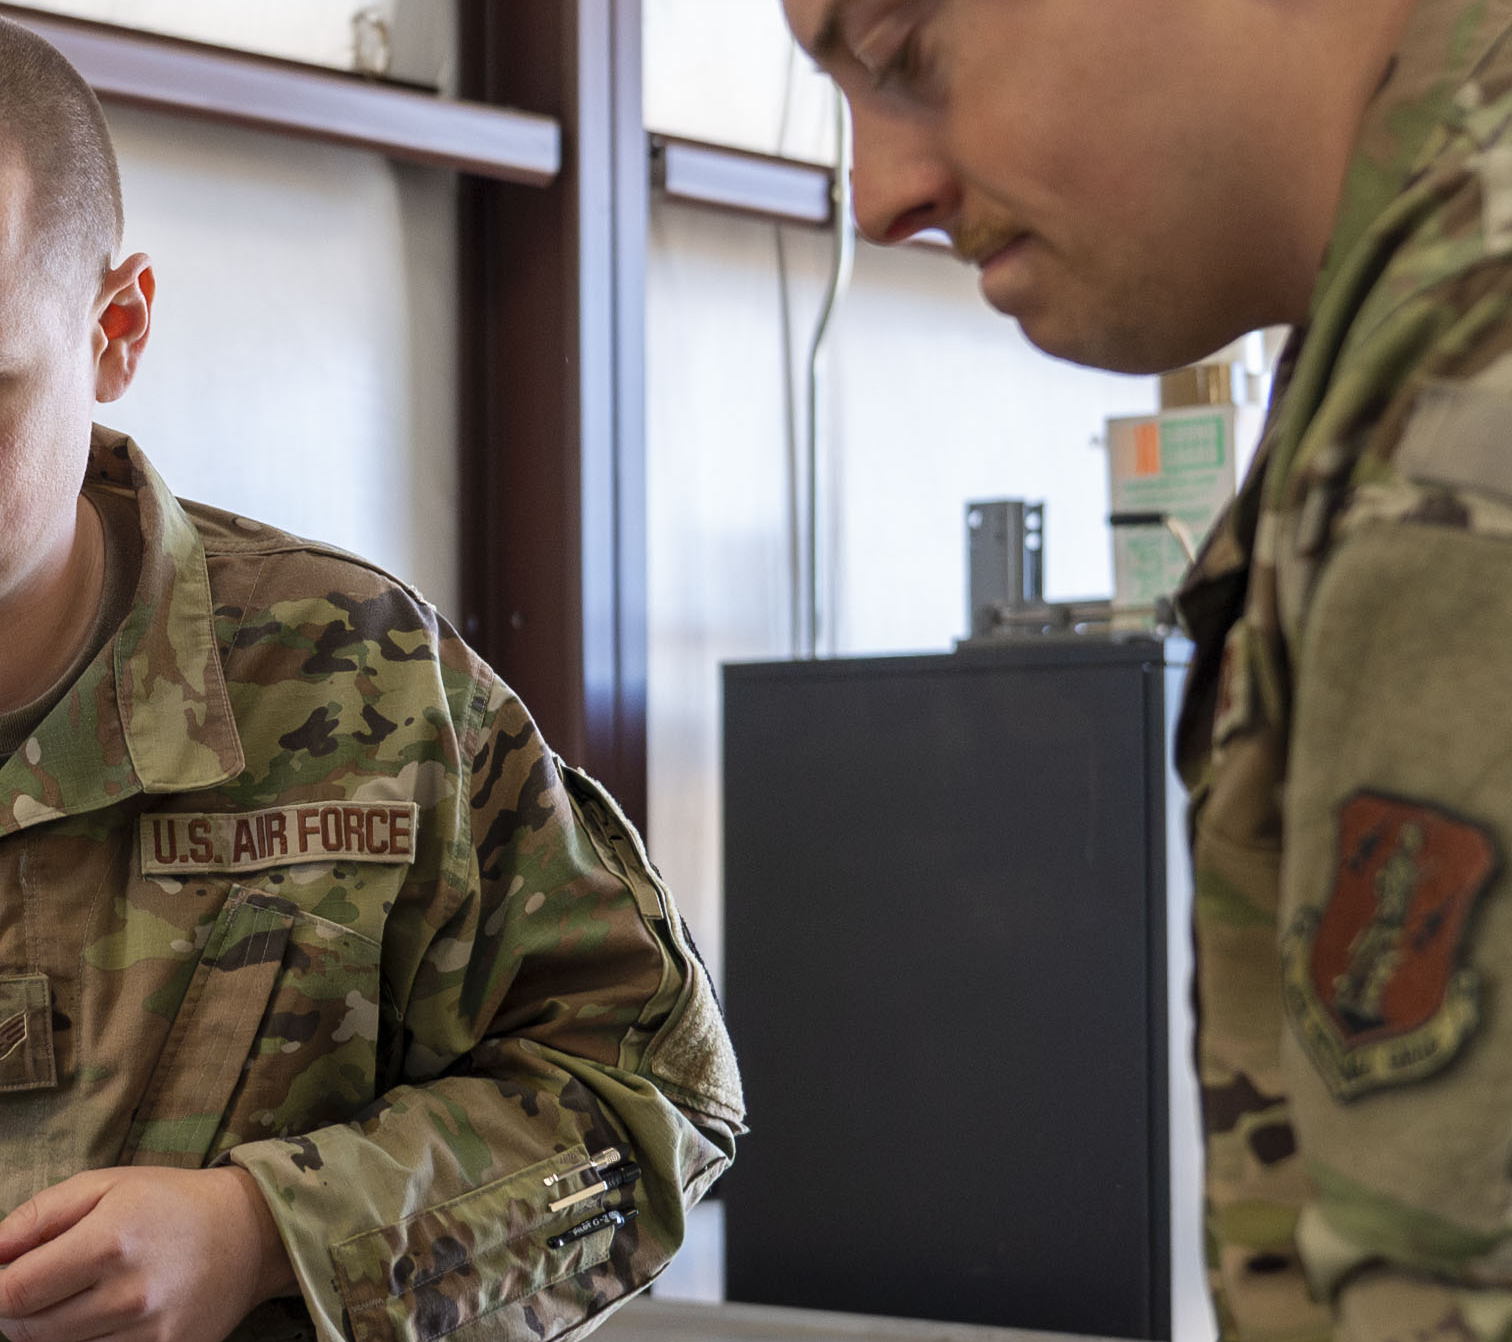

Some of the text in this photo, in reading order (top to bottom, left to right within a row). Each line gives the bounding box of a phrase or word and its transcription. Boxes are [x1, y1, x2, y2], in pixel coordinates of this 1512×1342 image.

[153, 806, 411, 864] U.S. AIR FORCE
[573, 1222, 592, 1236] PILOT
